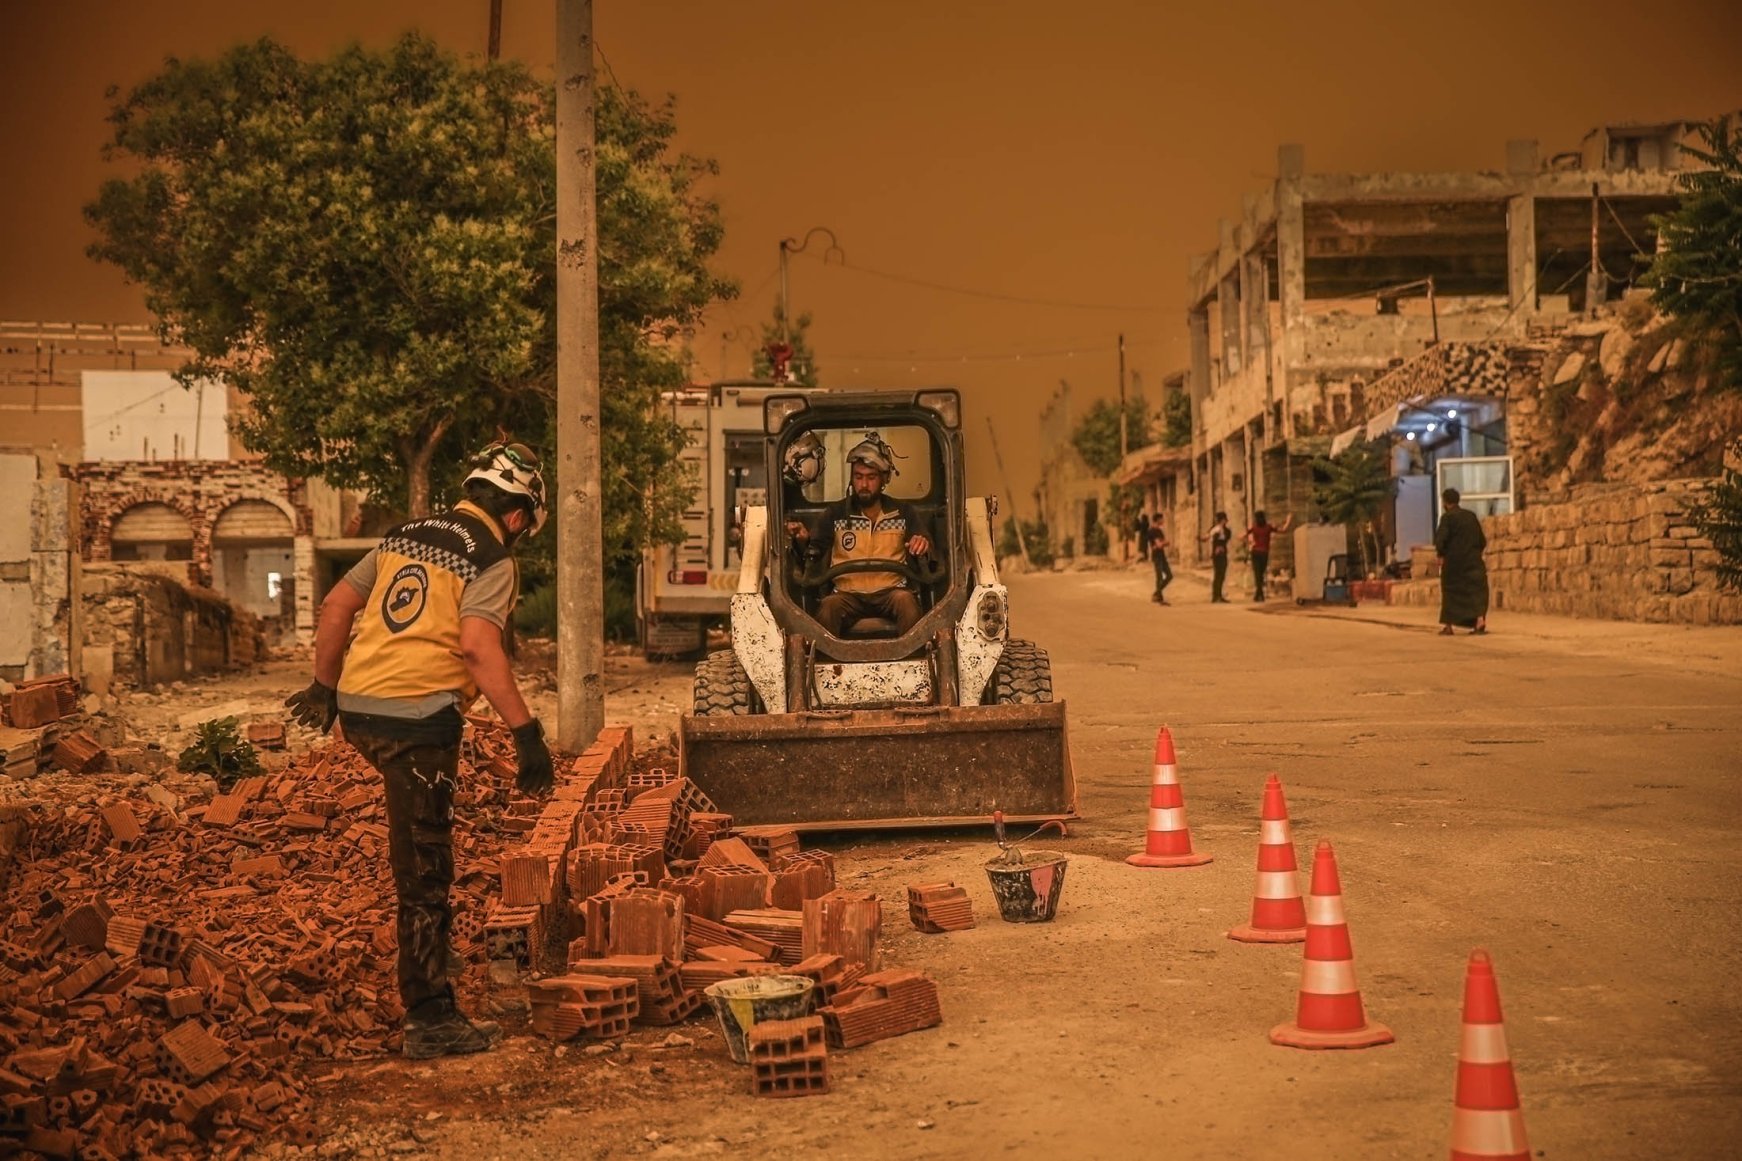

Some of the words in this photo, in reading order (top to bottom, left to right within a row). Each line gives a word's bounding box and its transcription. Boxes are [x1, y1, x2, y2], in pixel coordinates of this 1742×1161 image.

[401, 521, 421, 532] The
[423, 519, 451, 530] White
[449, 522, 476, 553] Helmets
